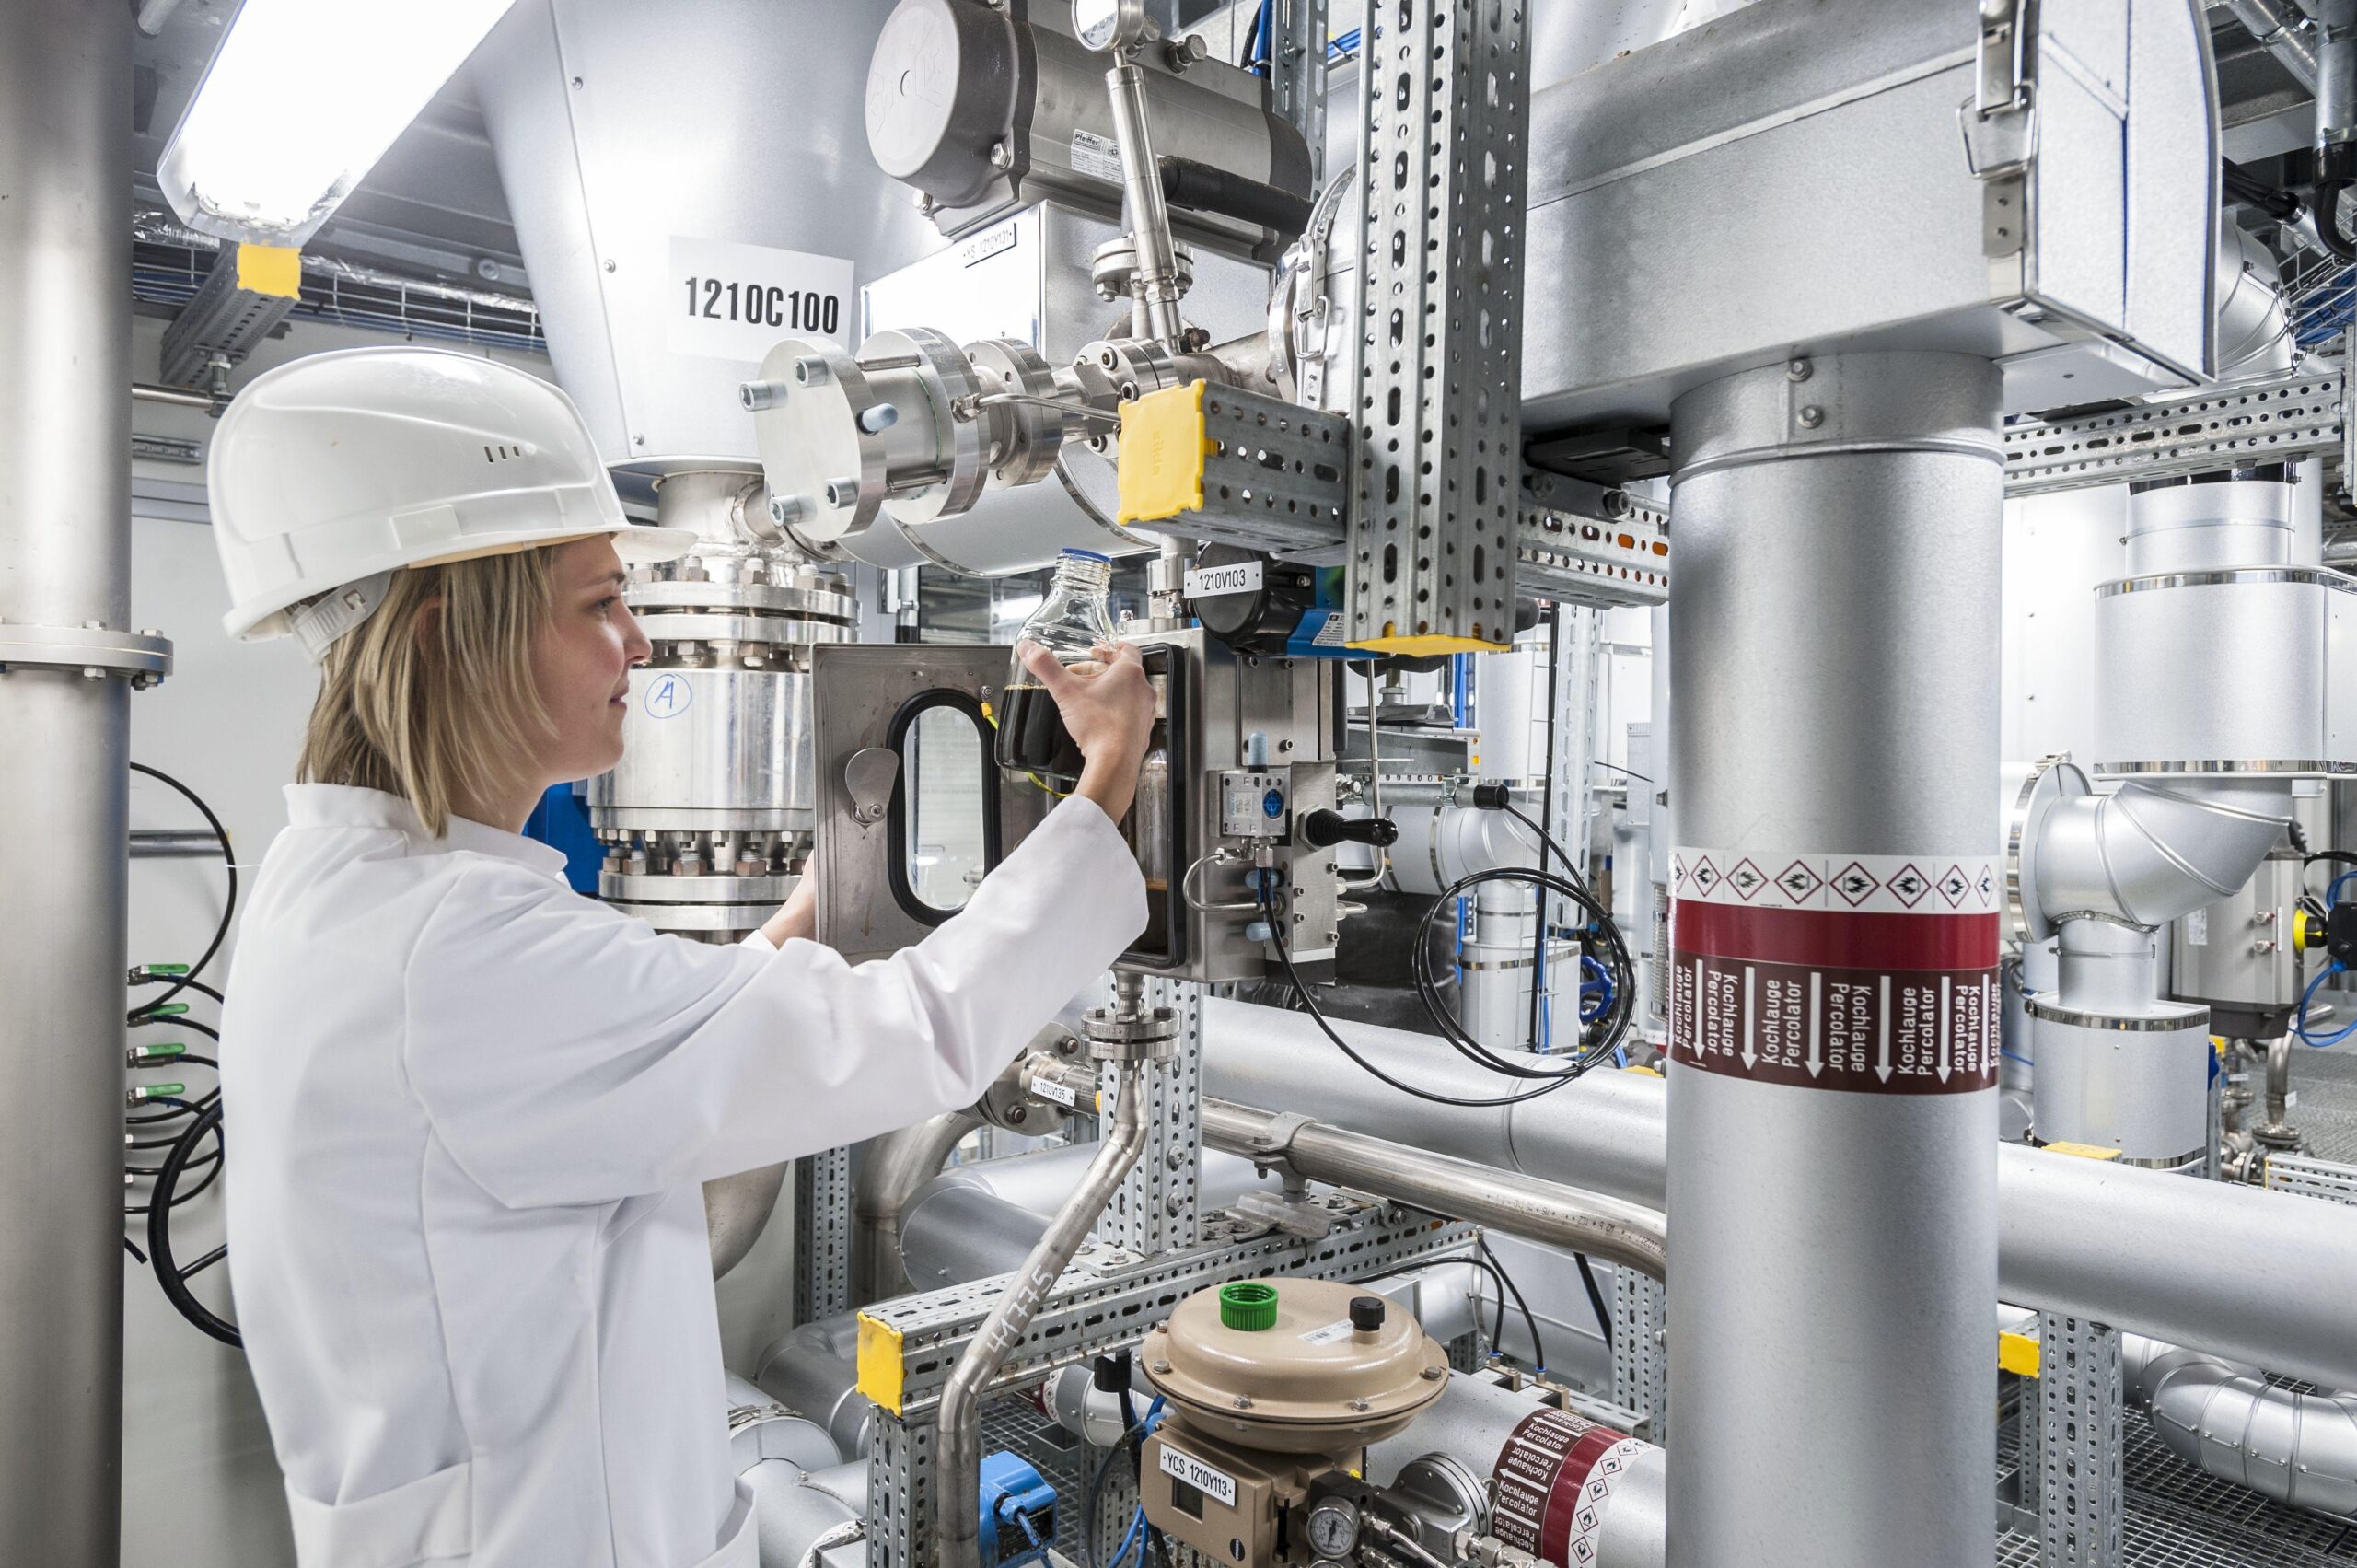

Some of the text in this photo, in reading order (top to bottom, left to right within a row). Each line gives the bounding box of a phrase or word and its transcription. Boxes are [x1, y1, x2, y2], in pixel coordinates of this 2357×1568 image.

[1075, 134, 1099, 145] Pfeiffer
[685, 277, 839, 334] 1210C100
[1199, 568, 1246, 591] 1210V103
[654, 681, 674, 709] A
[1682, 967, 1693, 1049] Percolator
[1707, 970, 1722, 1055] Percolator
[1722, 974, 1738, 1057] Kochlauge
[1761, 980, 1782, 1063] Kochlauge
[1782, 981, 1802, 1068] Percolator
[1829, 982, 1850, 1072] Percolator
[1850, 985, 1872, 1073] Kochlauge
[1897, 987, 1917, 1074] Kochlauge
[1917, 987, 1935, 1075] Percolator
[1955, 985, 1968, 1074] Percolator
[1967, 985, 1980, 1072] Kochlauge
[987, 1265, 1054, 1353] 41775
[1511, 1446, 1554, 1470] Percolator
[1522, 1428, 1564, 1451] Percolator
[1528, 1423, 1570, 1444] Kochlauge
[1167, 1452, 1227, 1496] YCS 1210Y113
[1499, 1480, 1539, 1505] Kochlauge
[1507, 1456, 1549, 1481] Kochlauge
[1494, 1516, 1535, 1540] Percolator
[1495, 1527, 1535, 1553] Kochlauge
